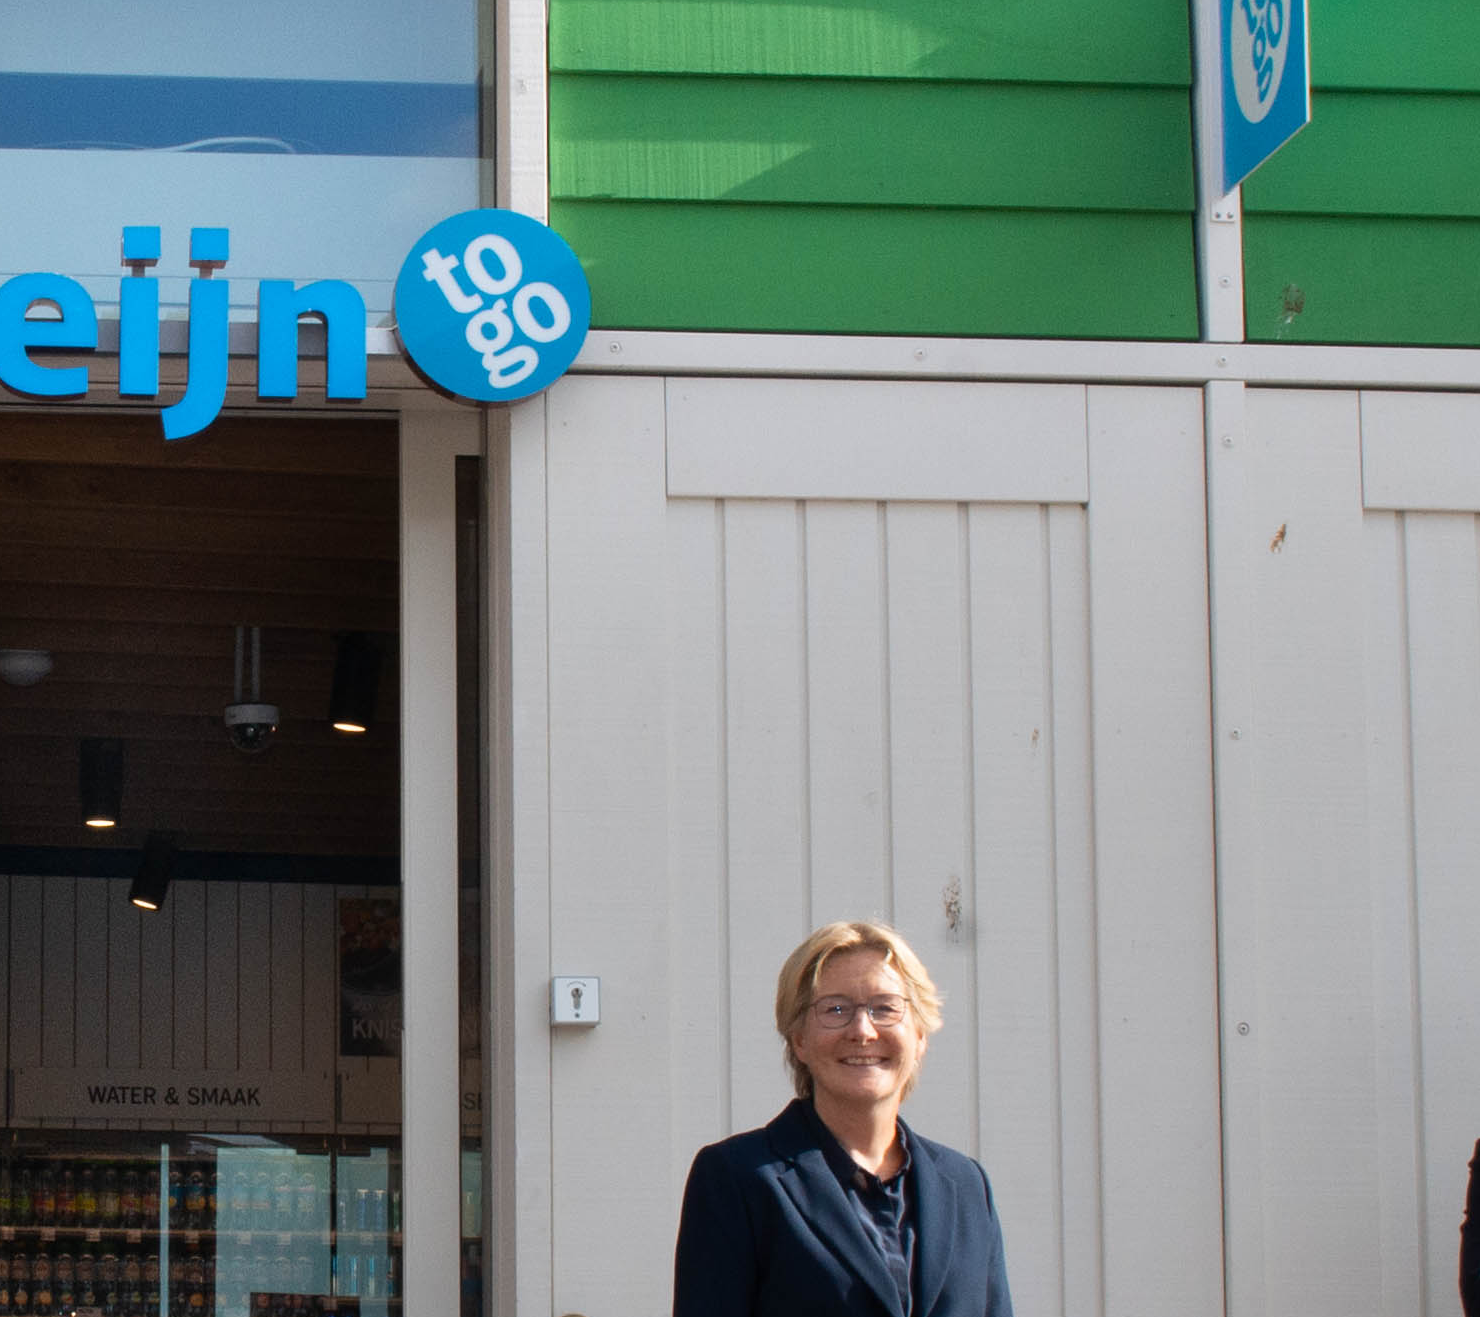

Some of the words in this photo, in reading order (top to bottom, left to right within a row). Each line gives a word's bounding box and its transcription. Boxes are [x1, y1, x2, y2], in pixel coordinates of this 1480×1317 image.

[420, 233, 523, 314] to
[465, 281, 572, 389] go
[87, 1085, 156, 1105] WATER
[164, 1087, 180, 1105] &
[187, 1087, 261, 1106] SMAAK
